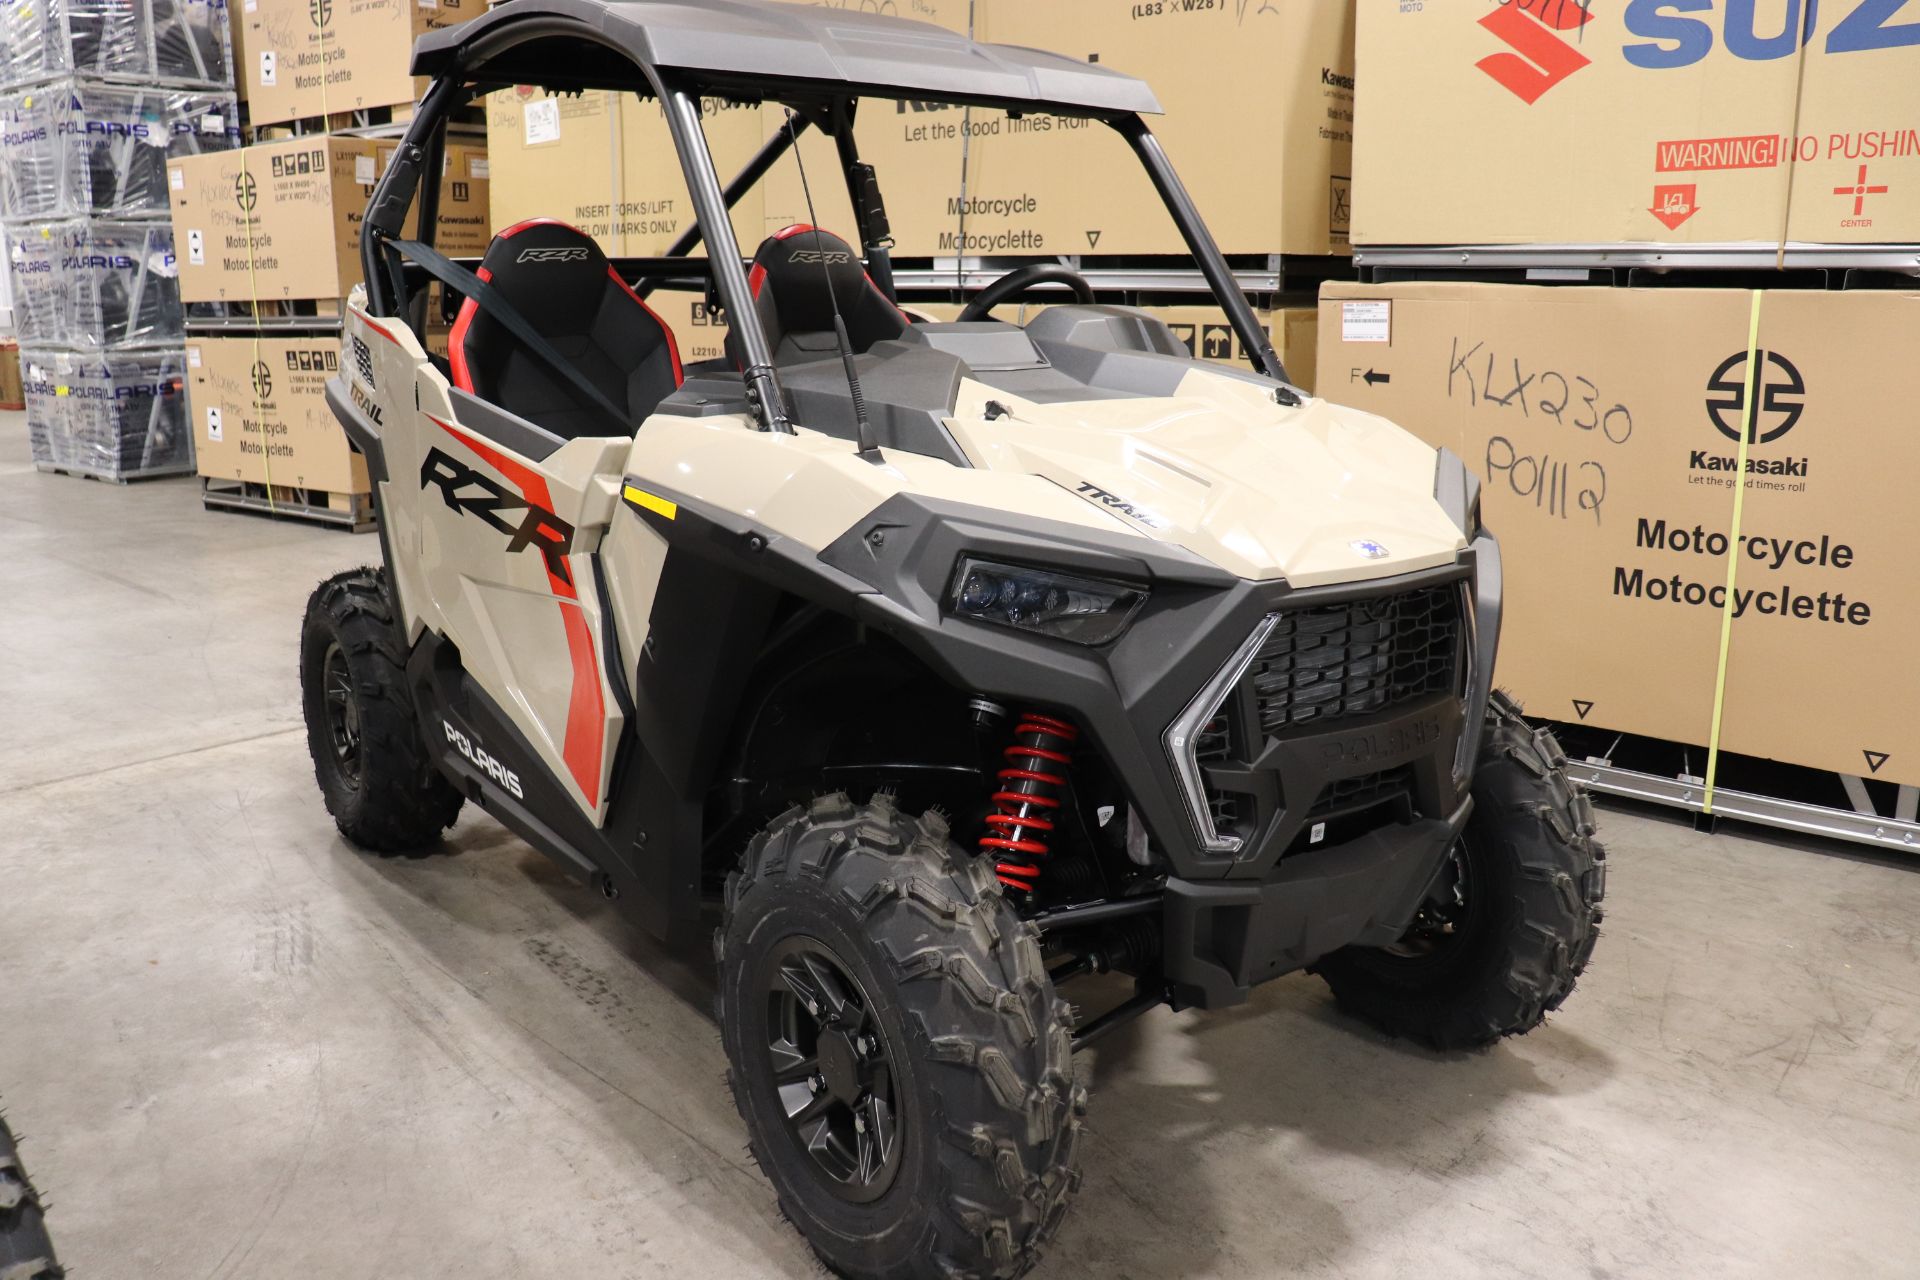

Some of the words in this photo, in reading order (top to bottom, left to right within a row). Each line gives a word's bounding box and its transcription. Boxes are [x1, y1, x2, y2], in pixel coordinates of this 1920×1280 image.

[1399, 2, 1423, 13] MOTO
[308, 30, 336, 42] Kawsaki
[58, 121, 149, 138] POLARIS
[905, 124, 928, 142] Let
[932, 121, 956, 140] the
[961, 117, 1000, 137] Good
[1005, 113, 1051, 133] Times
[4, 127, 46, 147] POLARIS
[1661, 138, 1775, 168] WARNING!
[1781, 135, 1818, 162] NO
[575, 204, 610, 219] INSERT
[948, 193, 1037, 217] Motorcycle
[235, 215, 261, 225] Kawsaki
[650, 219, 677, 234] ONLY
[1840, 219, 1872, 228] CENTER
[938, 229, 1043, 253] Motocyclette
[62, 255, 133, 271] POLARIS
[517, 247, 588, 263] RZR
[789, 250, 849, 264] RZR
[11, 260, 51, 273] POLARIS
[692, 347, 717, 356] L2210
[1351, 367, 1362, 384] F
[1449, 336, 1632, 444] KLX230
[350, 382, 383, 426] TRAIL
[1689, 450, 1808, 477] Kawasaki
[1688, 475, 1704, 484] Let
[1706, 475, 1724, 486] the
[1726, 479, 1753, 489] god
[1756, 480, 1785, 491] times
[1788, 483, 1806, 492] roll
[421, 446, 575, 588] RZR
[1636, 518, 1854, 570] Motorcycle
[1612, 566, 1871, 626] Motocyclette
[443, 719, 524, 800] POLARIS
